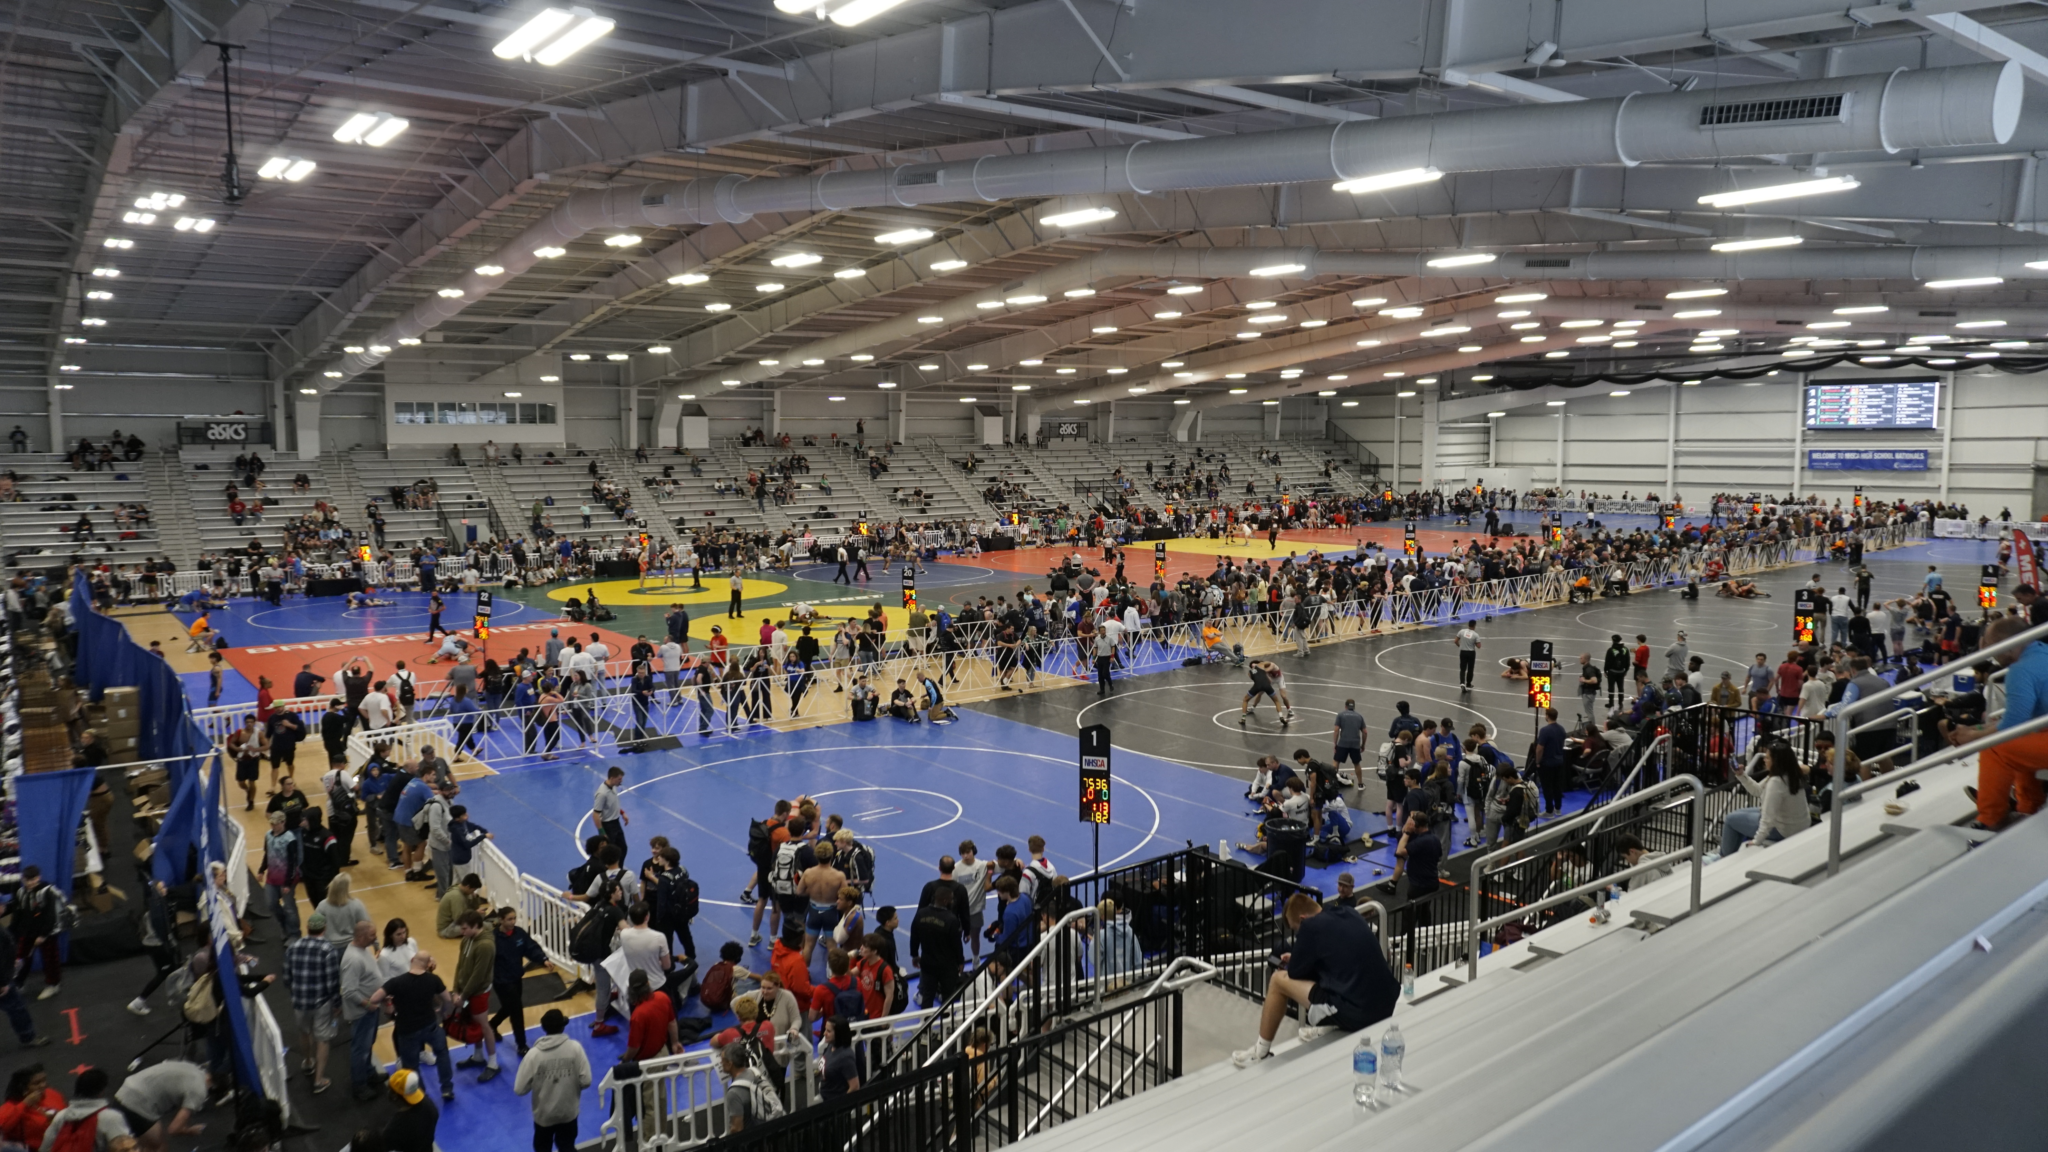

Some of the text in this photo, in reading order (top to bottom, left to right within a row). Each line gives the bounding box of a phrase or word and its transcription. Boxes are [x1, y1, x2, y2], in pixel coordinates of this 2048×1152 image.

[1808, 398, 1817, 406] 2
[1807, 408, 1816, 416] 3
[903, 569, 913, 577] 20
[480, 592, 490, 601] 22
[1802, 590, 1808, 600] 3
[1543, 643, 1550, 654] 2
[1091, 730, 1097, 746] 1
[1084, 758, 1106, 768] NHSCA
